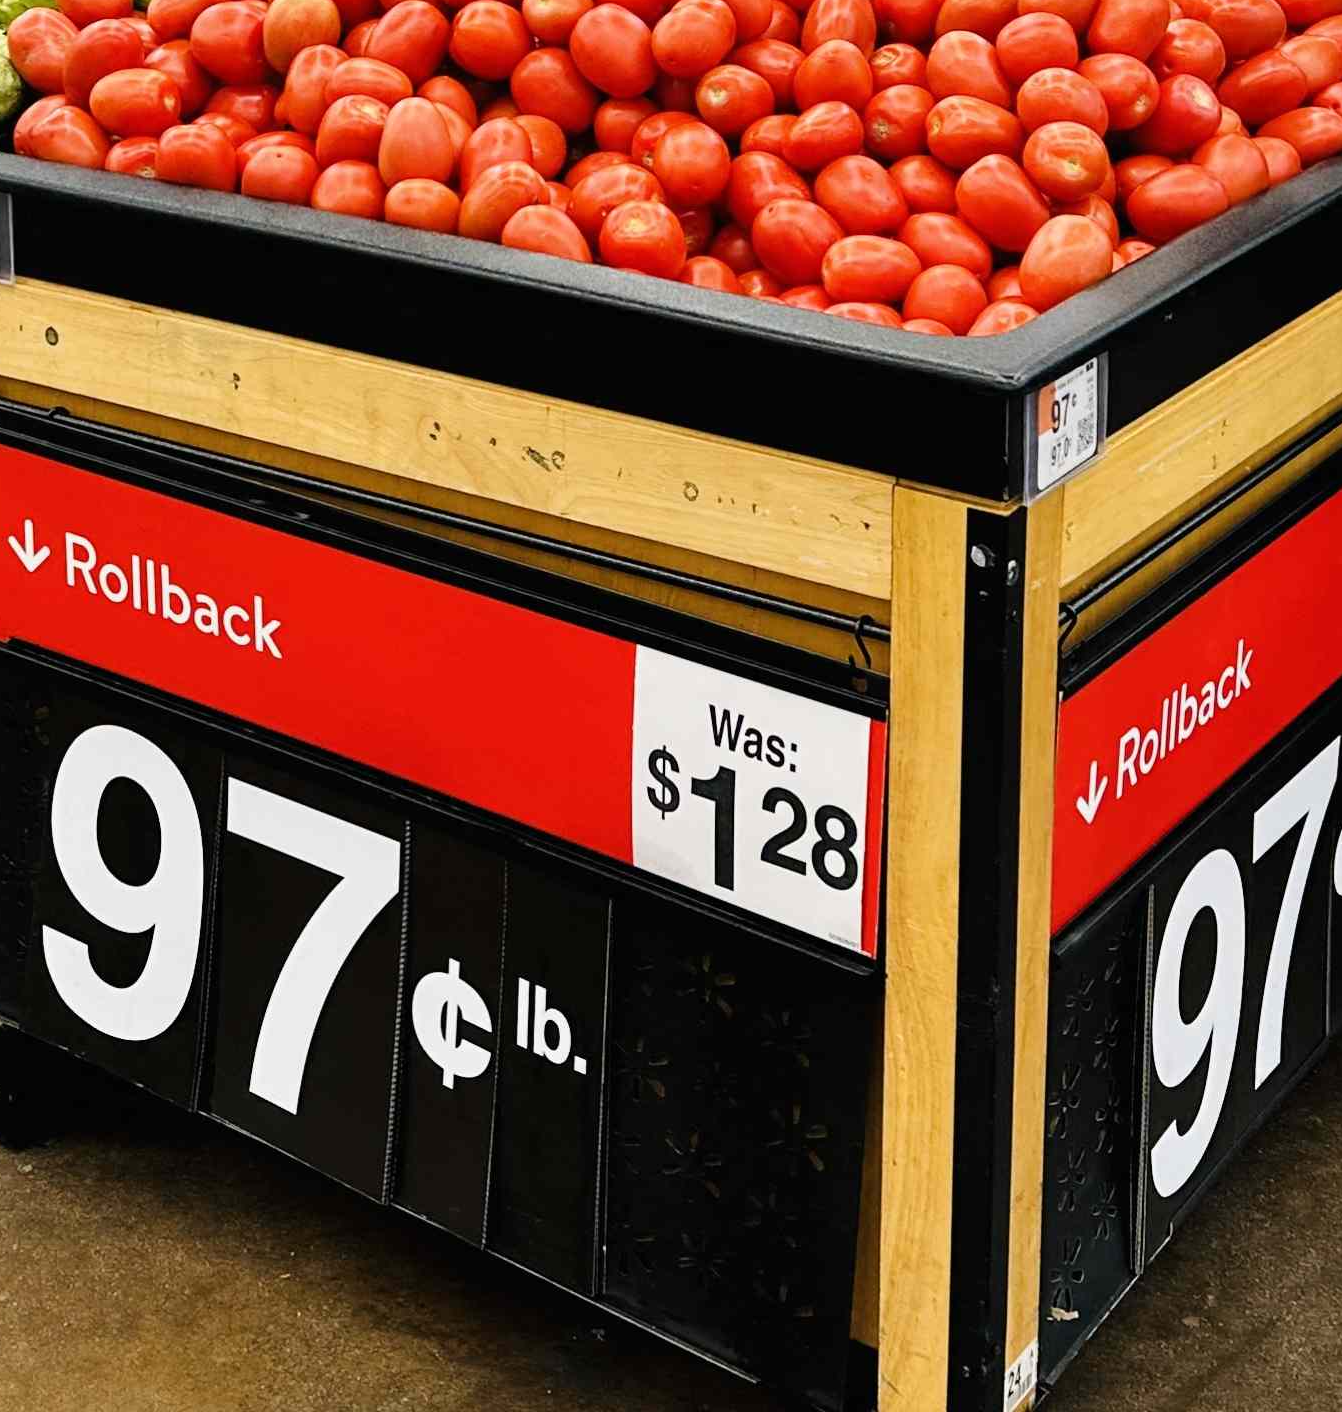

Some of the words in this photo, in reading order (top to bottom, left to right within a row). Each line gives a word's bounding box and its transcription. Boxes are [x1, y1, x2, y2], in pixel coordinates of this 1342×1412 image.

[66, 532, 283, 659] Rollback
[709, 703, 799, 774] Was:
[1116, 637, 1254, 799] Rollback
[516, 976, 588, 1075] lb.
